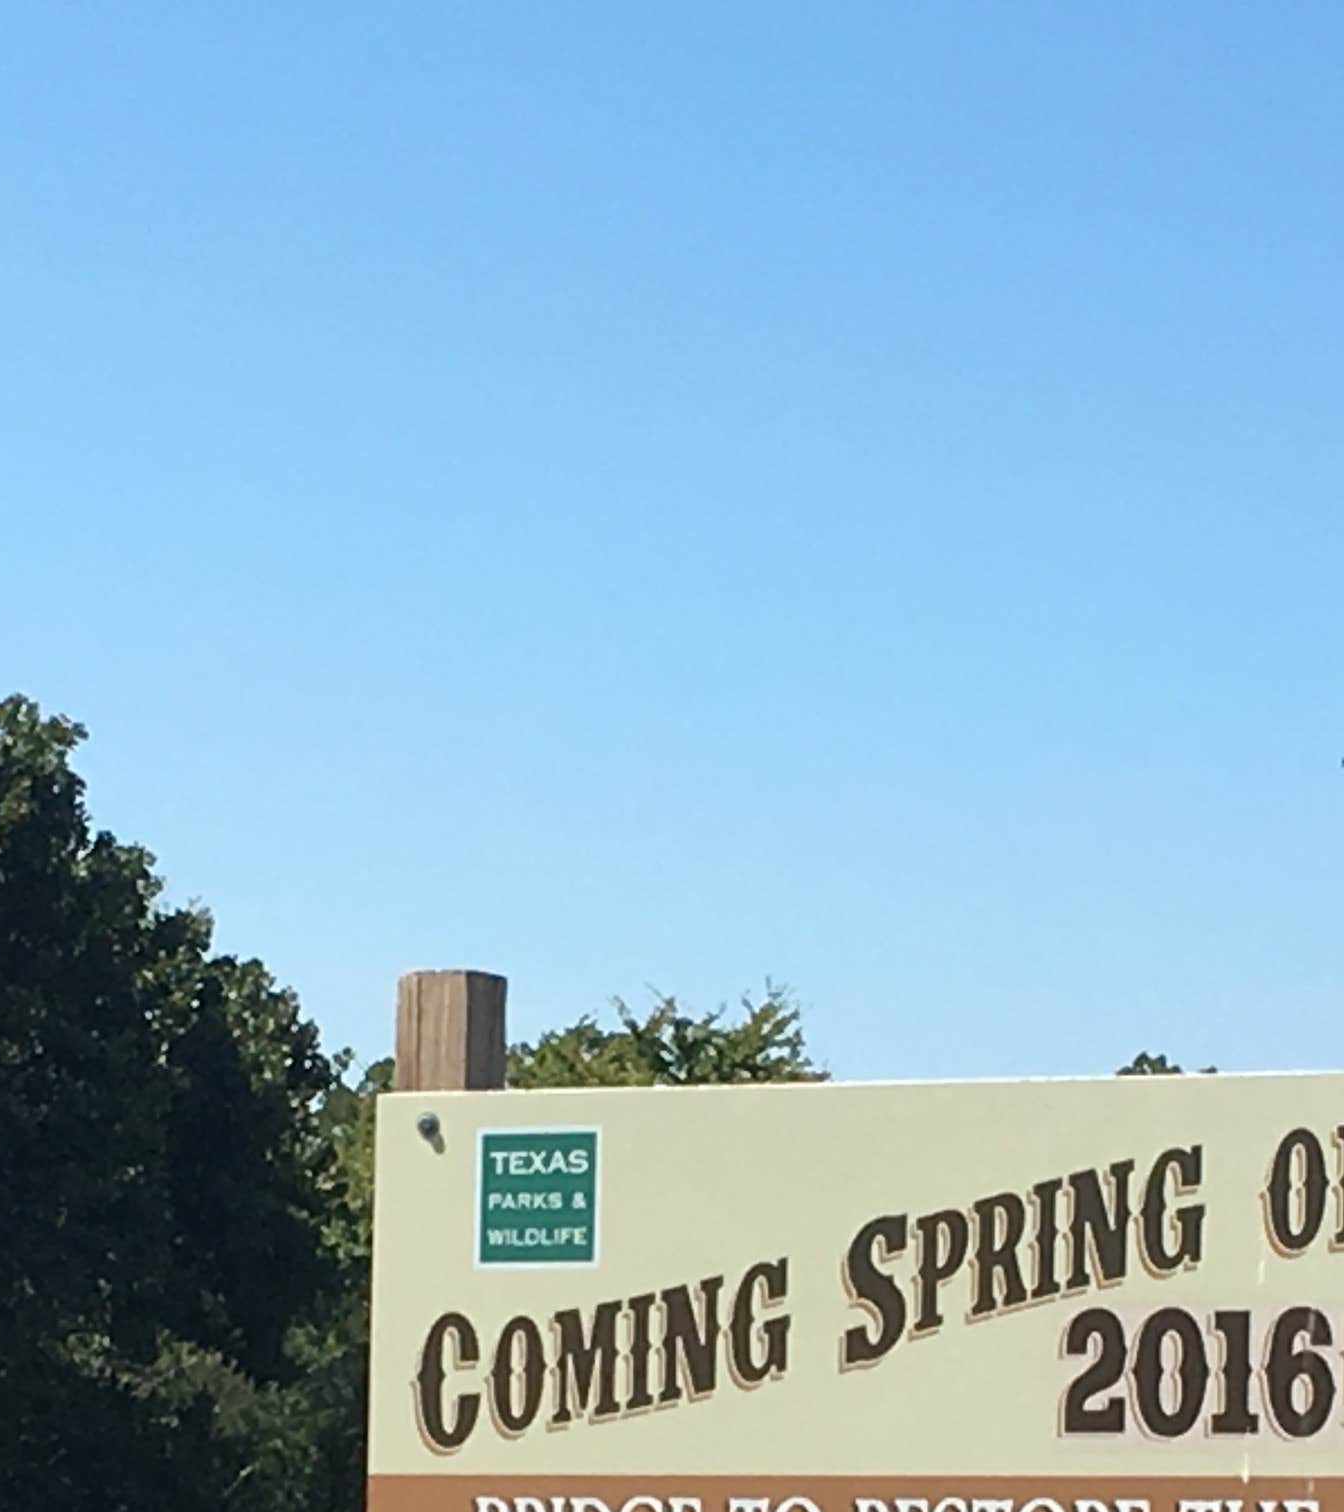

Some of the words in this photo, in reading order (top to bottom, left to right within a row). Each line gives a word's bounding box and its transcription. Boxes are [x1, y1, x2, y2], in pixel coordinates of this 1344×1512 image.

[490, 1149, 589, 1175] TEXAS
[488, 1192, 562, 1211] PARKS
[572, 1192, 587, 1210] &
[487, 1226, 588, 1247] WILDLIFE
[412, 1257, 792, 1456] COMING
[839, 1145, 1205, 1374] SPRING
